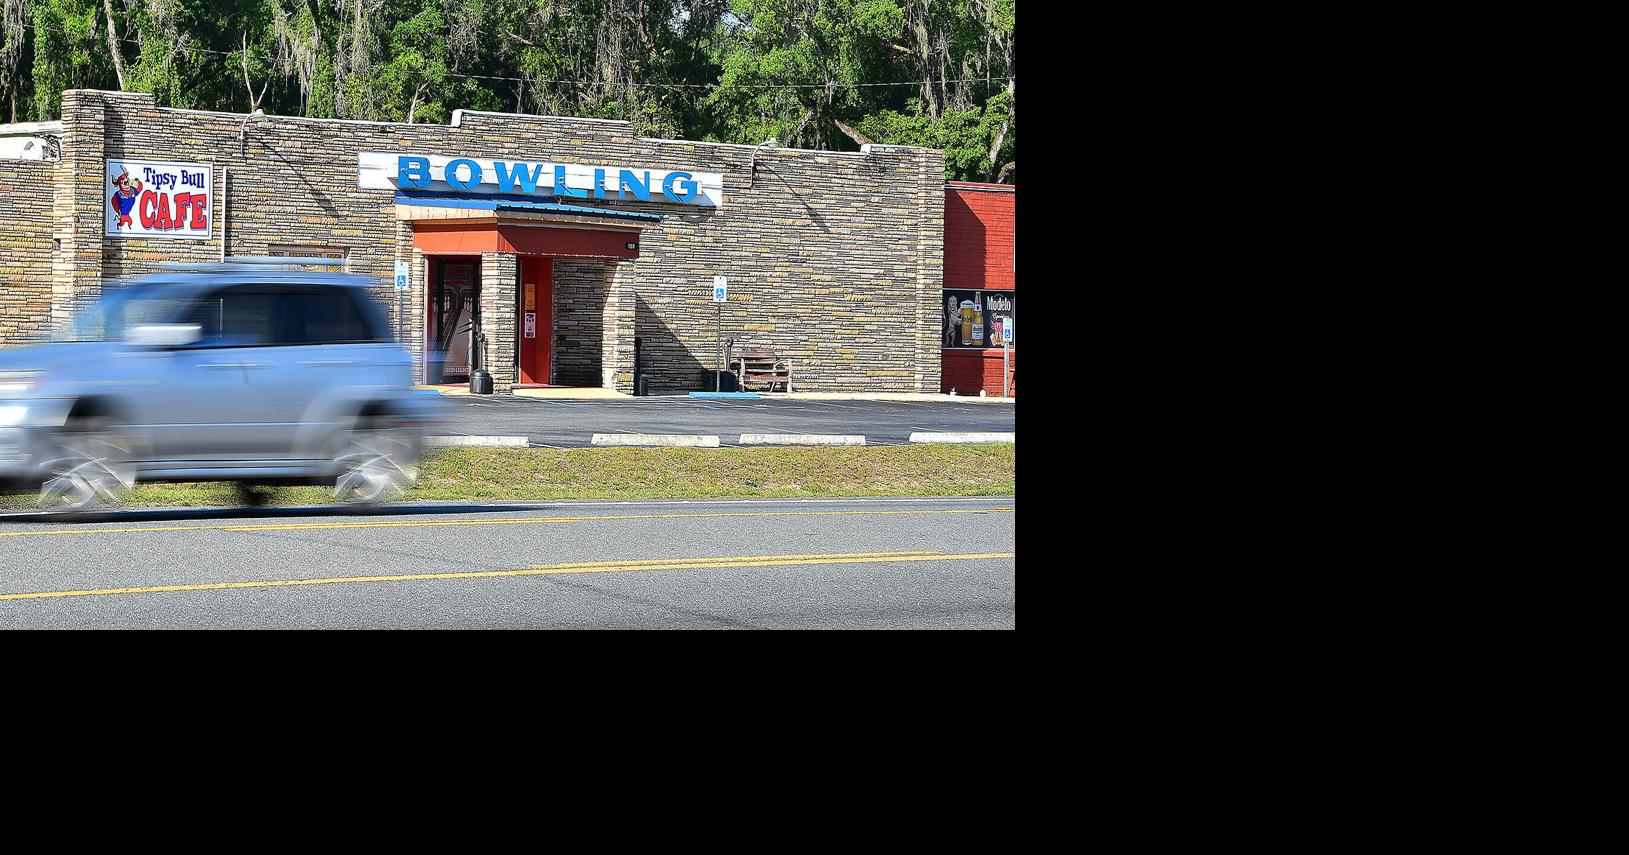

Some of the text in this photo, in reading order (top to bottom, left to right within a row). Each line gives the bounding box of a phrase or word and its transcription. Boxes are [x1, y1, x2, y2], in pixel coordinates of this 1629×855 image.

[143, 167, 205, 190] Tipsy Bull
[397, 155, 699, 203] BOWLING
[139, 190, 207, 231] CAFE
[986, 296, 1011, 311] Modelo
